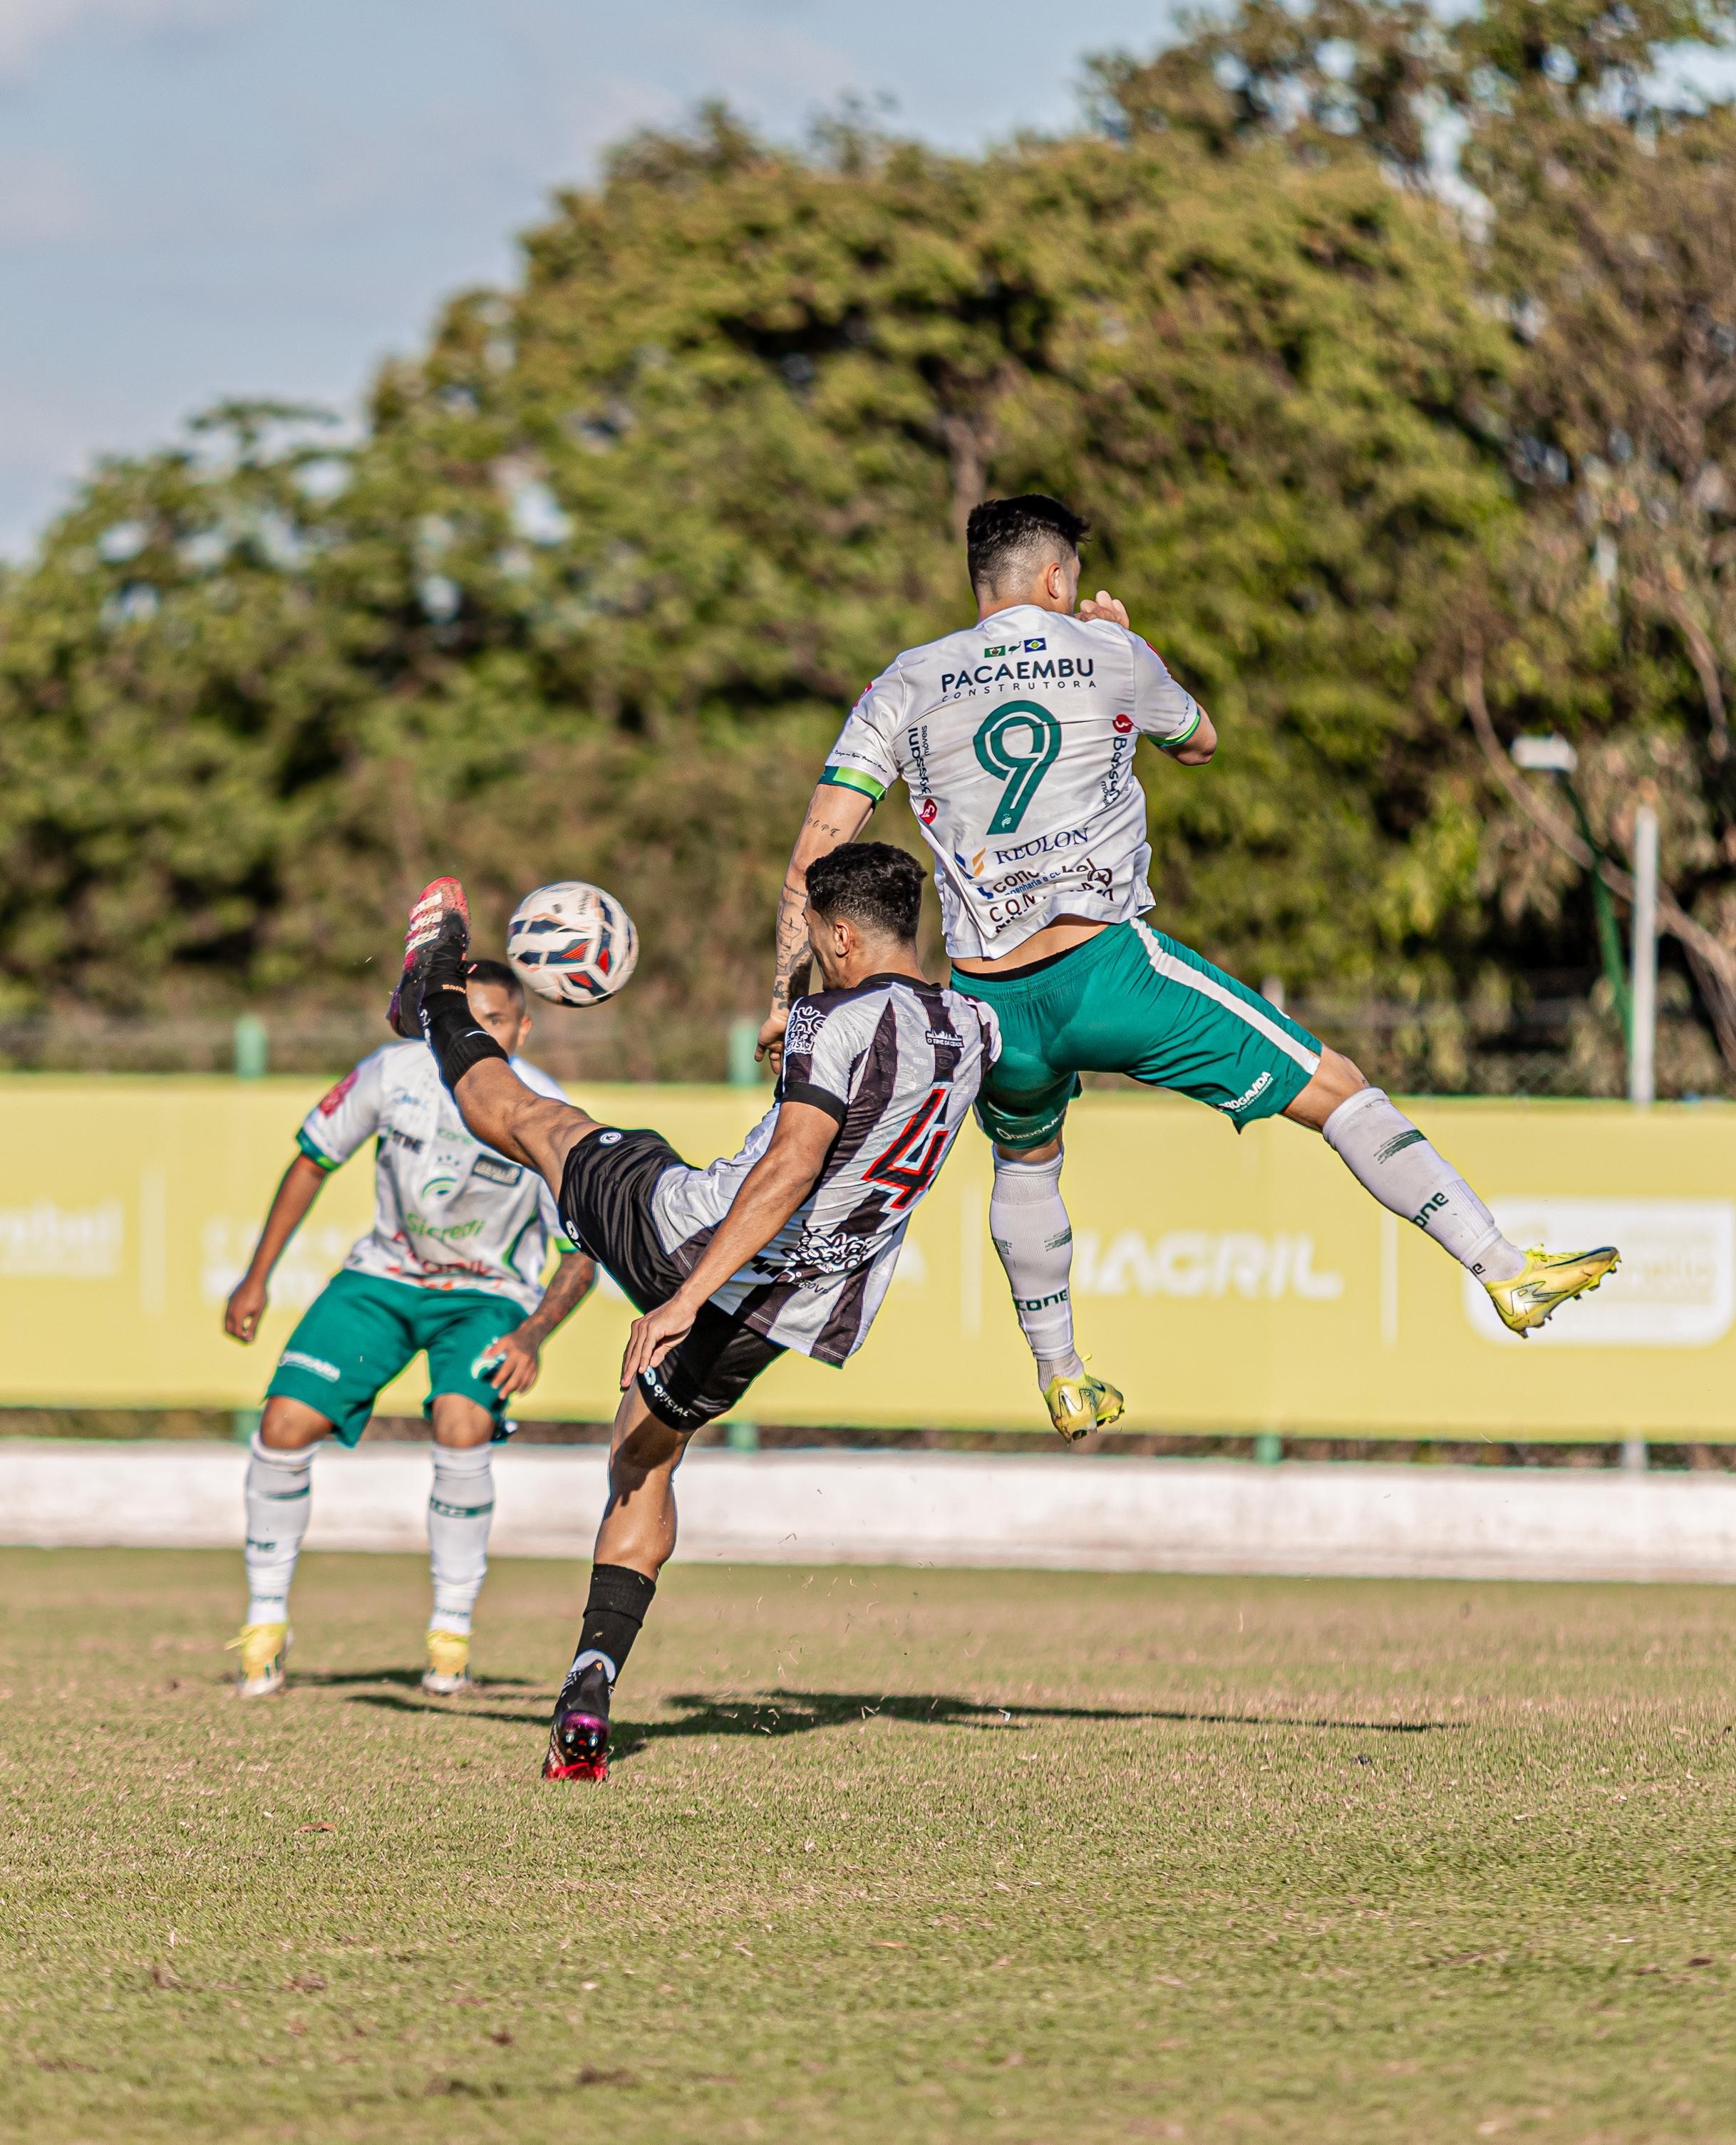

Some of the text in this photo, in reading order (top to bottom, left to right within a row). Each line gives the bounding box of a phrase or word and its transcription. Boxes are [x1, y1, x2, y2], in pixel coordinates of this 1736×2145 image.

[941, 658, 1094, 693] PACAEMBU
[941, 680, 1097, 703] CONSTRUTORA
[973, 700, 1061, 835] 9
[862, 1088, 950, 1209] 4
